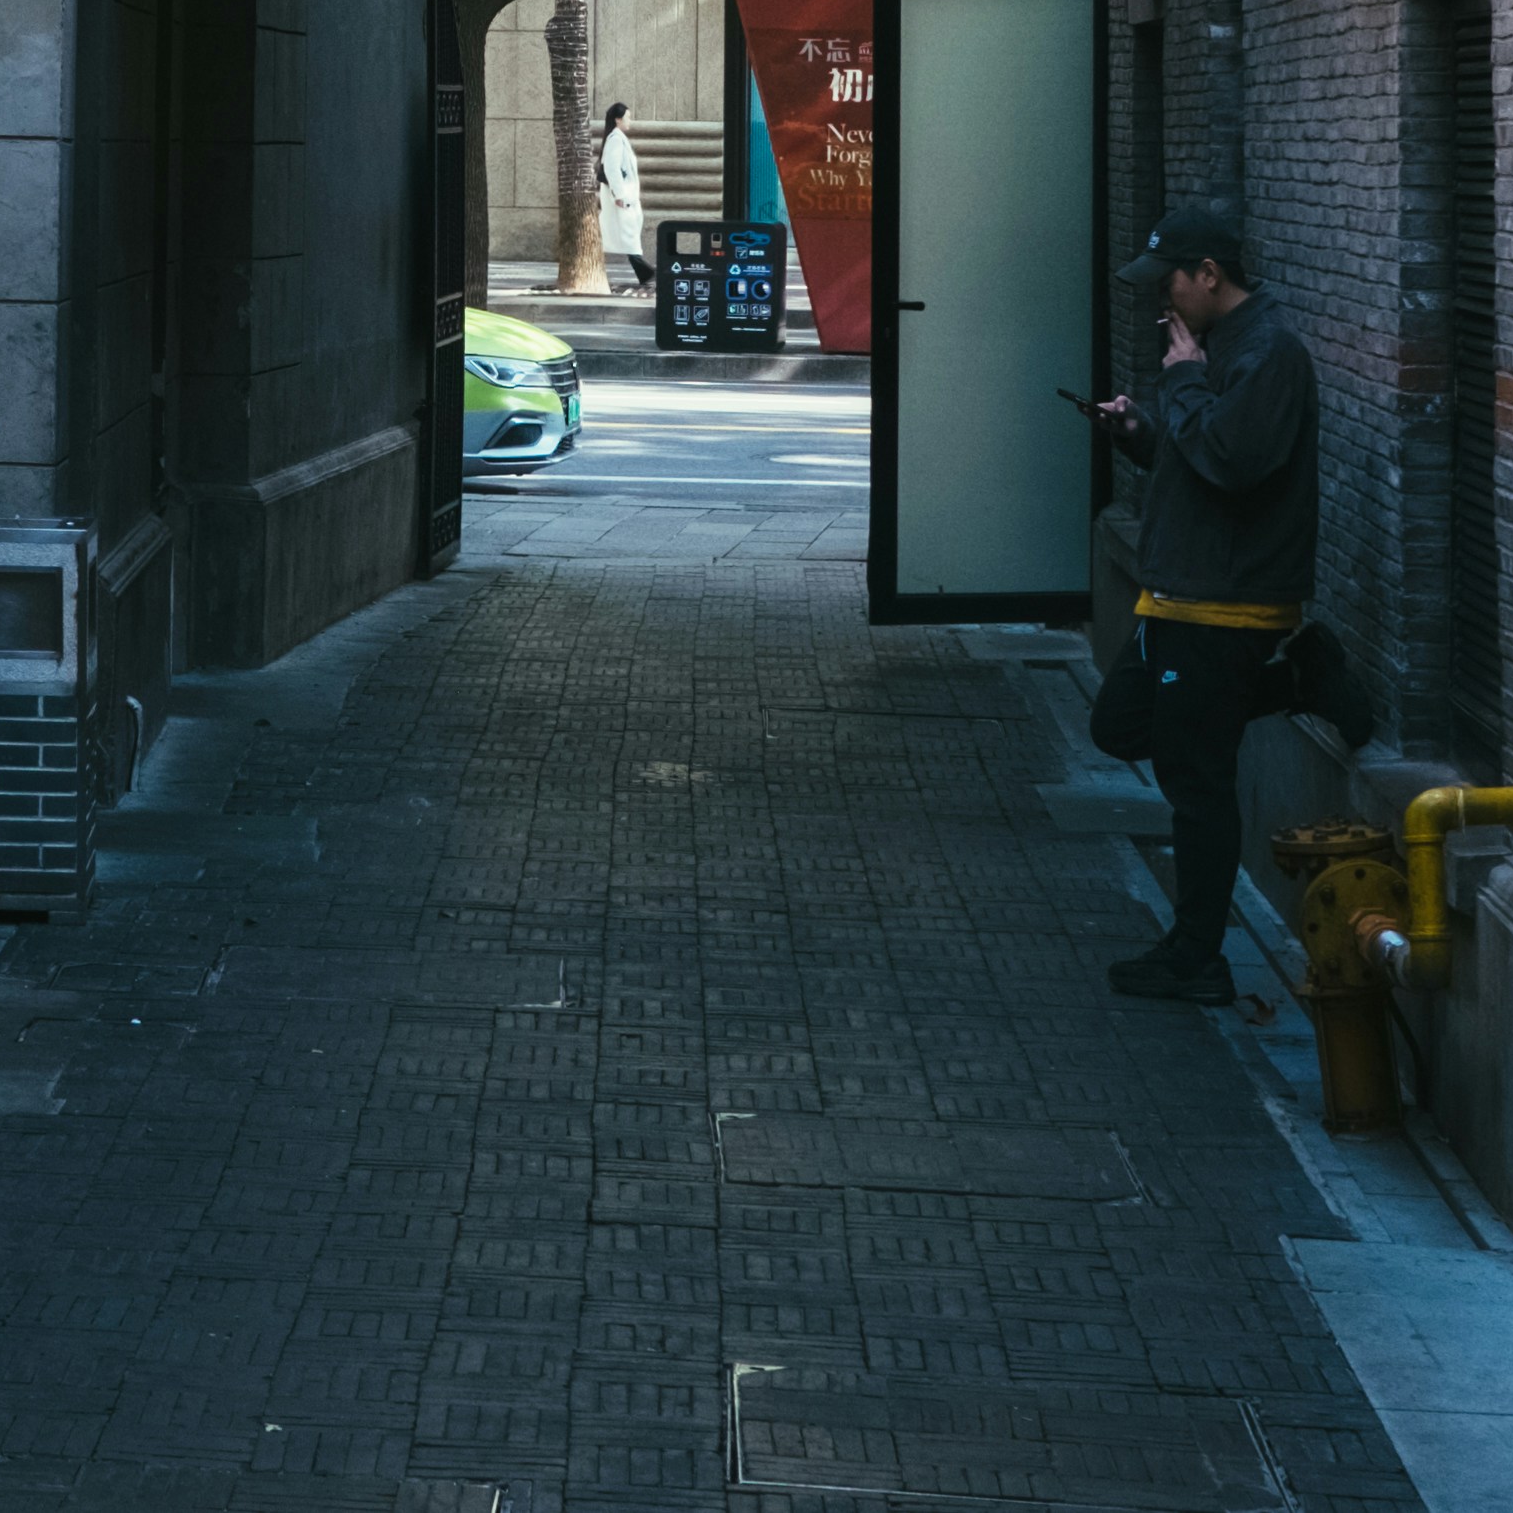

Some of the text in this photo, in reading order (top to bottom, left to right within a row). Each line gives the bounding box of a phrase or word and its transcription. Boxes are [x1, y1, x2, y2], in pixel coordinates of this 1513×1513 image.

[798, 37, 851, 63] 不忘
[825, 143, 873, 169] Forg
[810, 168, 873, 190] Why Y
